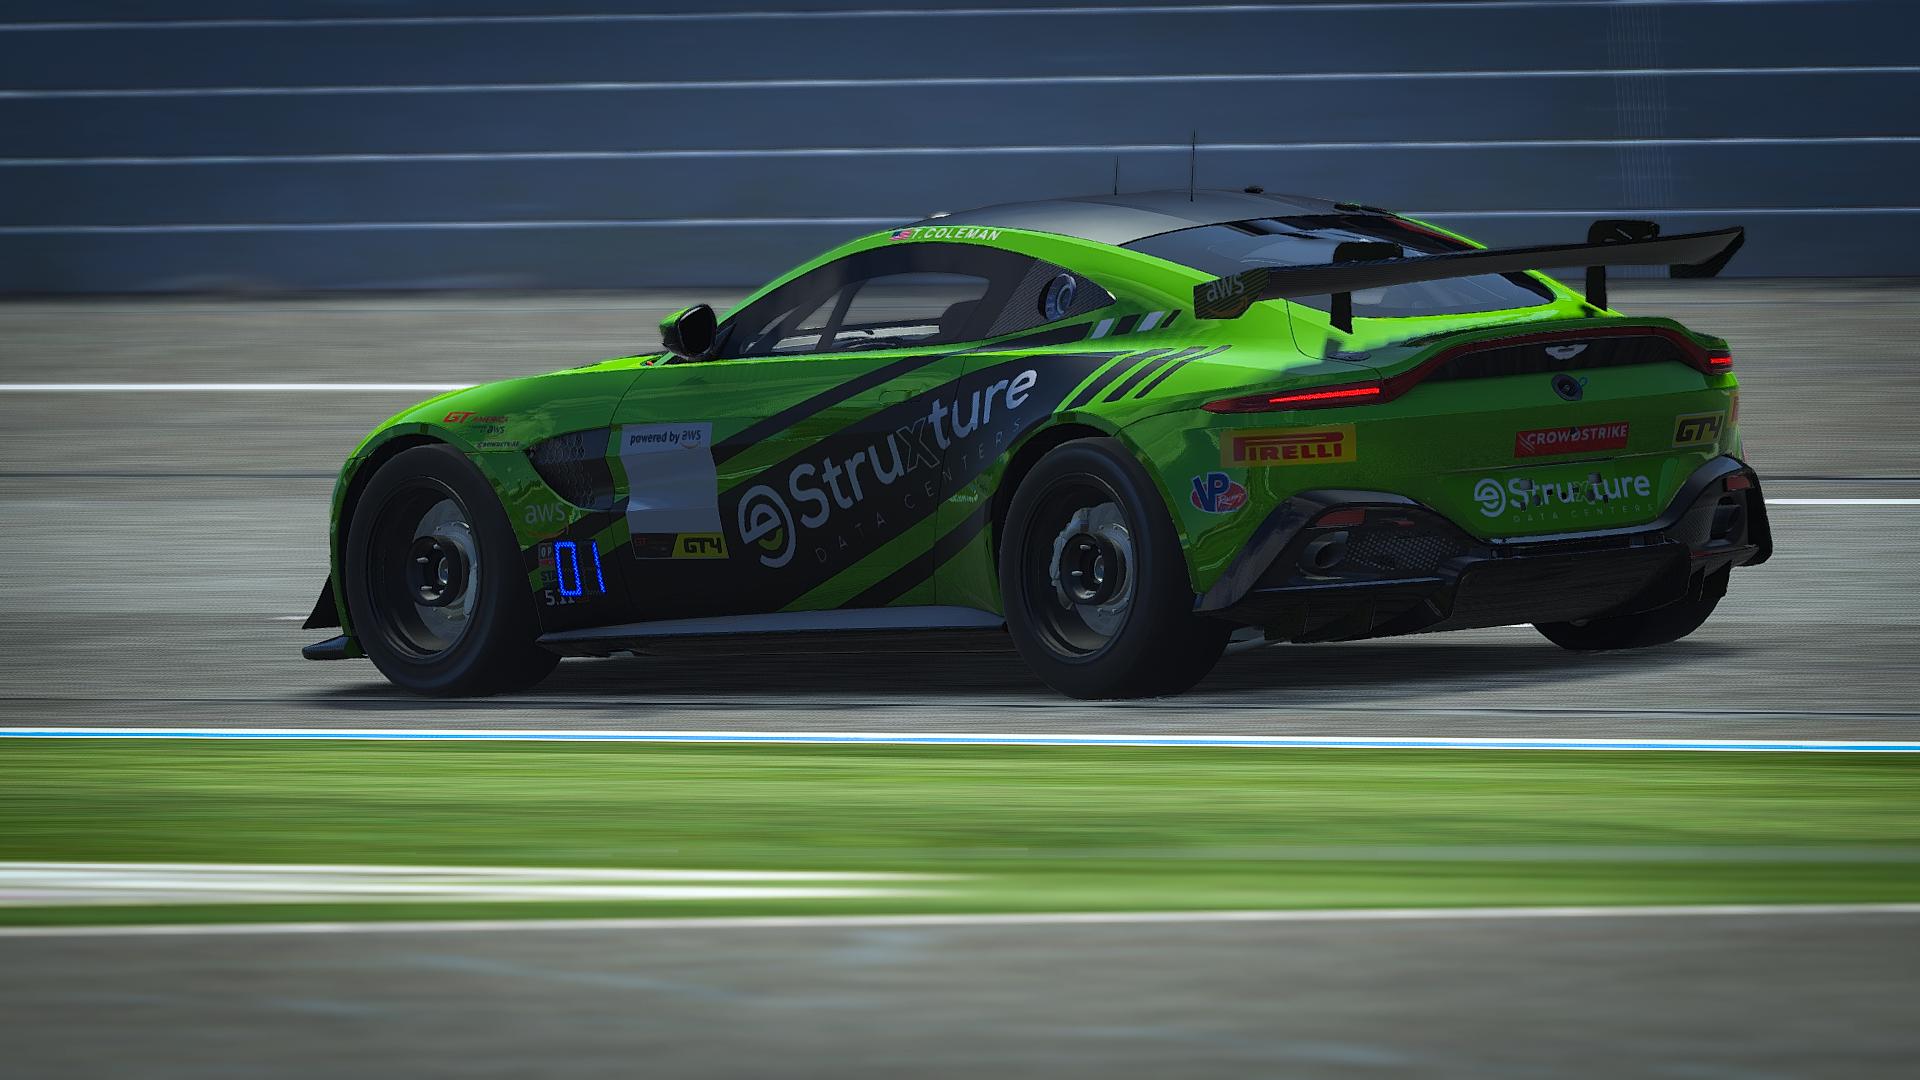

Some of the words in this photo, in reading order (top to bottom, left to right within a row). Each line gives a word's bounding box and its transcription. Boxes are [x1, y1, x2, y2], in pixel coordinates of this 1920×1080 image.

[911, 228, 1001, 241] T.COLEMAN
[1207, 274, 1245, 303] aws
[442, 412, 479, 424] GT
[1675, 415, 1724, 443] GT4
[630, 432, 667, 446] powered
[669, 431, 680, 444] by
[682, 430, 701, 441] aws
[1233, 431, 1345, 462] PIRELLI
[1527, 423, 1628, 446] CROWDSTRIKE
[814, 511, 889, 563] DATA
[903, 417, 1022, 510] CENTERS
[1191, 473, 1230, 513] VP
[524, 503, 566, 525] aws
[684, 537, 722, 554] GT4
[553, 540, 608, 597] 01
